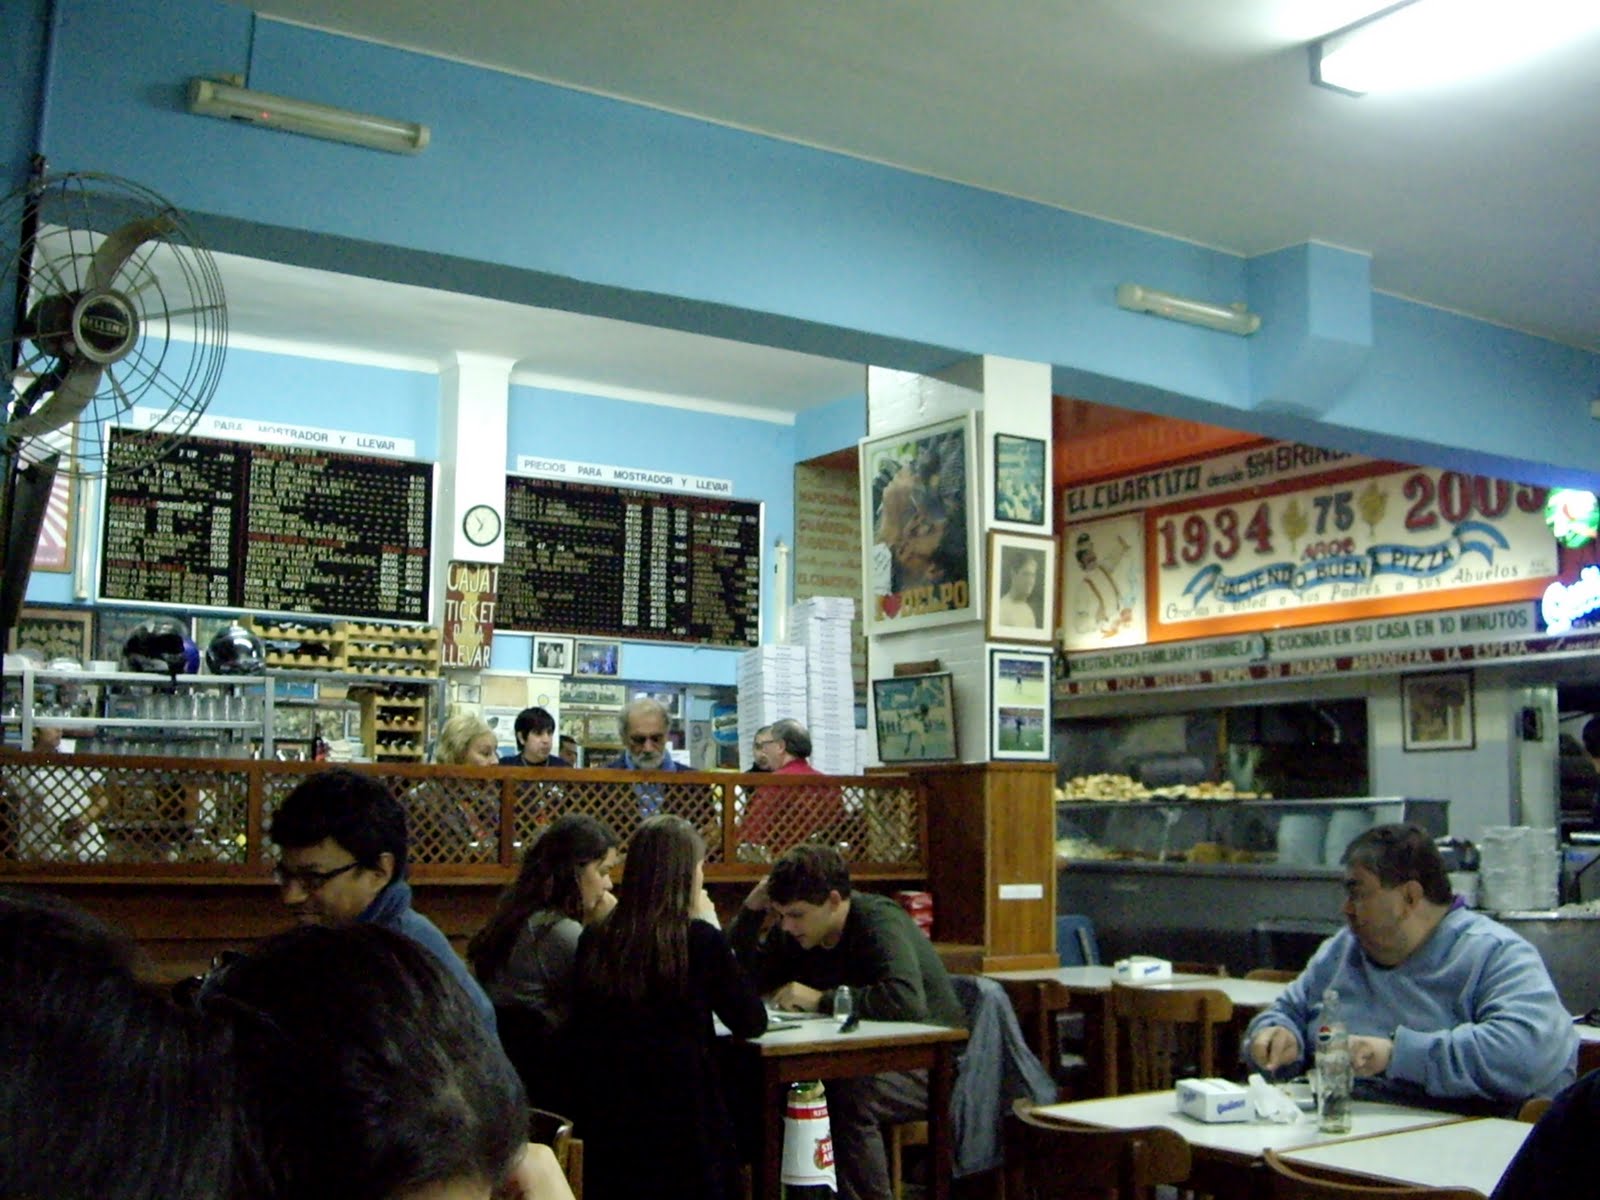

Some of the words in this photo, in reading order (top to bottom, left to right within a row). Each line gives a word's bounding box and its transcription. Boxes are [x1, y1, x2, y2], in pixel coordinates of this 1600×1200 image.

[213, 420, 244, 432] PARA
[258, 425, 329, 443] MOSTRADOR
[339, 435, 346, 445] Y
[356, 438, 396, 451] LLEVAR
[524, 459, 566, 473] PRECIOS
[577, 466, 602, 477] PARA
[613, 470, 673, 486] MOSTRADOR
[681, 478, 688, 487] Y
[696, 481, 729, 491] LLEVAR
[1068, 490, 1089, 514] EL
[1092, 465, 1203, 509] CUARTITO
[1159, 502, 1274, 570] 1934
[1313, 491, 1355, 535] 75
[447, 562, 491, 594] CAJA
[1216, 567, 1306, 597] HACIENDO
[1391, 546, 1455, 573] PIZZA
[1331, 583, 1381, 602] Padres
[1417, 579, 1441, 589] sus
[1451, 564, 1519, 584] Abuelos
[445, 600, 496, 624] TICKET
[1279, 629, 1332, 650] COCINAR
[1334, 627, 1351, 645] EN
[1355, 625, 1373, 643] SU
[1376, 619, 1412, 641] CASA
[1416, 618, 1434, 637] EN
[1439, 616, 1456, 634] 10
[1460, 608, 1528, 632] MINUTOS
[442, 643, 491, 668] LLEVAR
